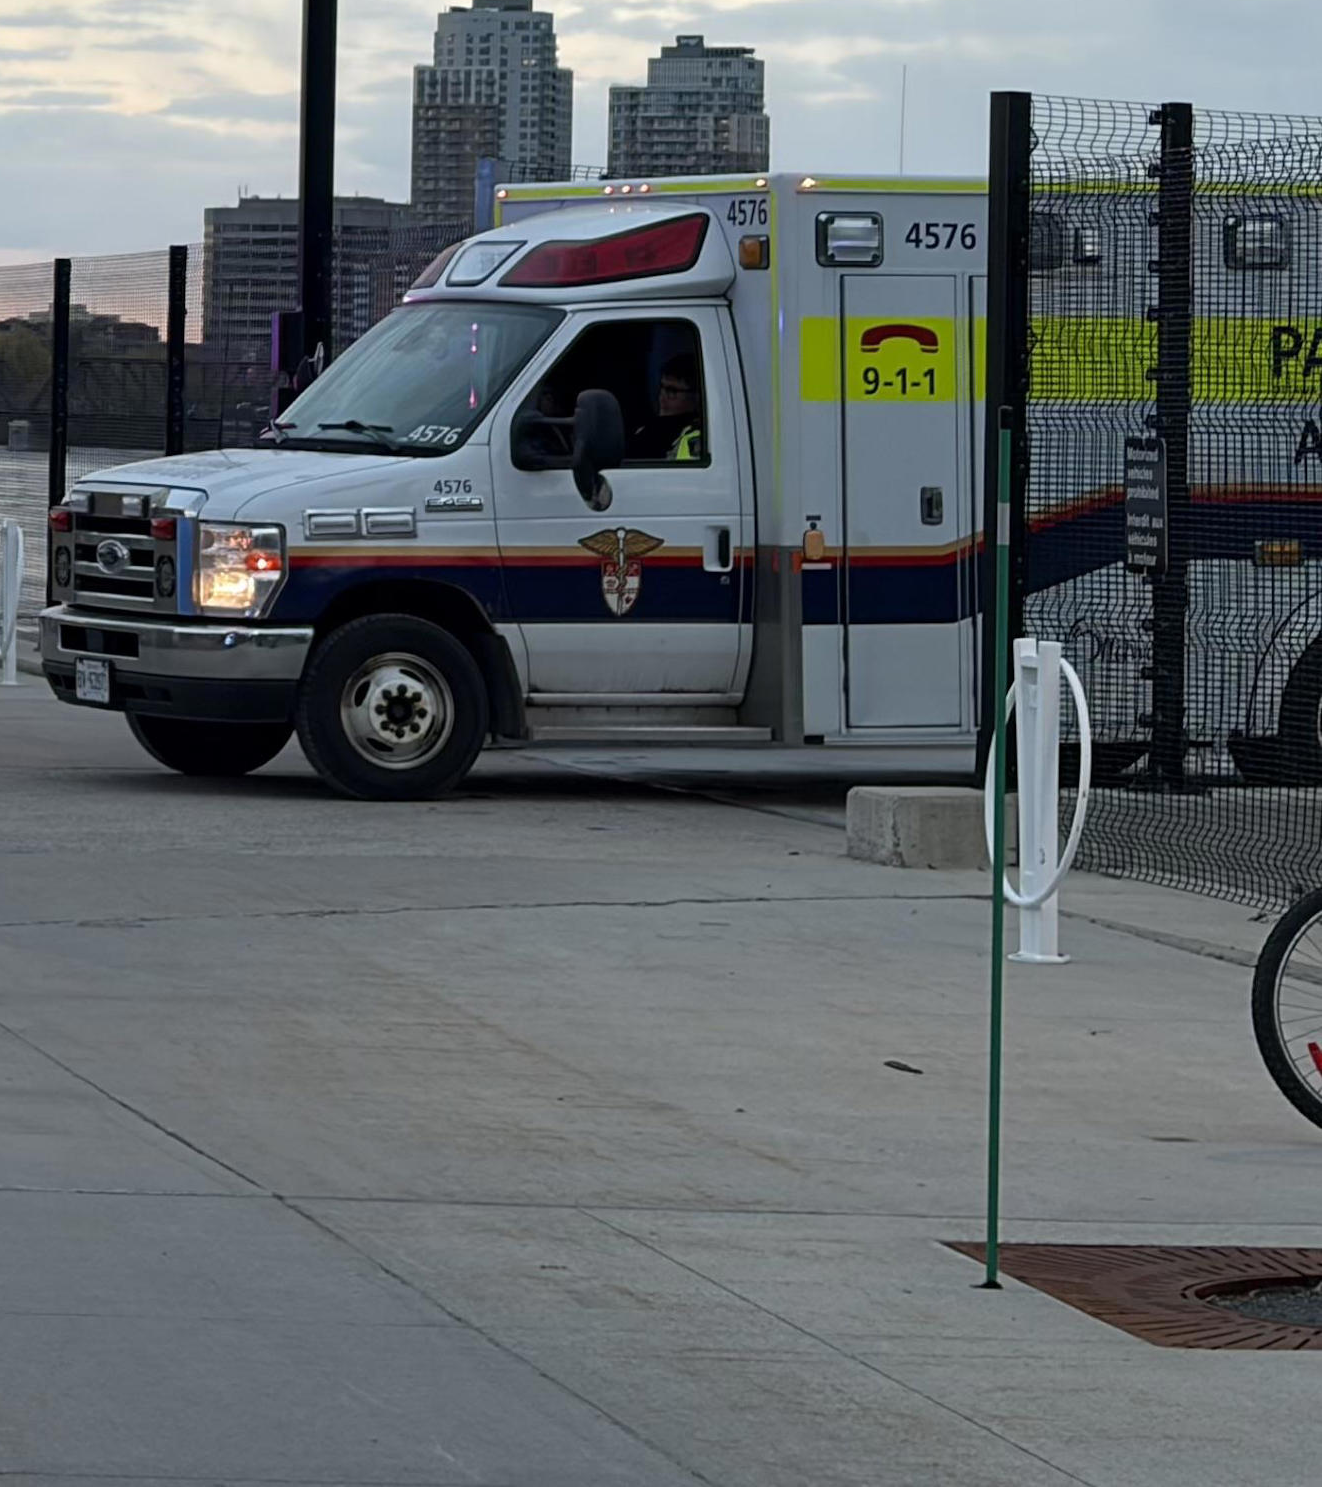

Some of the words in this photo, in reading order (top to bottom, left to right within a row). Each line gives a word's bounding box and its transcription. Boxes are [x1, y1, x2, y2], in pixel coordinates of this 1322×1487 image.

[727, 199, 768, 226] 4576
[905, 222, 977, 250] 4576
[862, 367, 936, 395] 9-1-1
[407, 424, 463, 446] 4576
[433, 479, 472, 494] 4576
